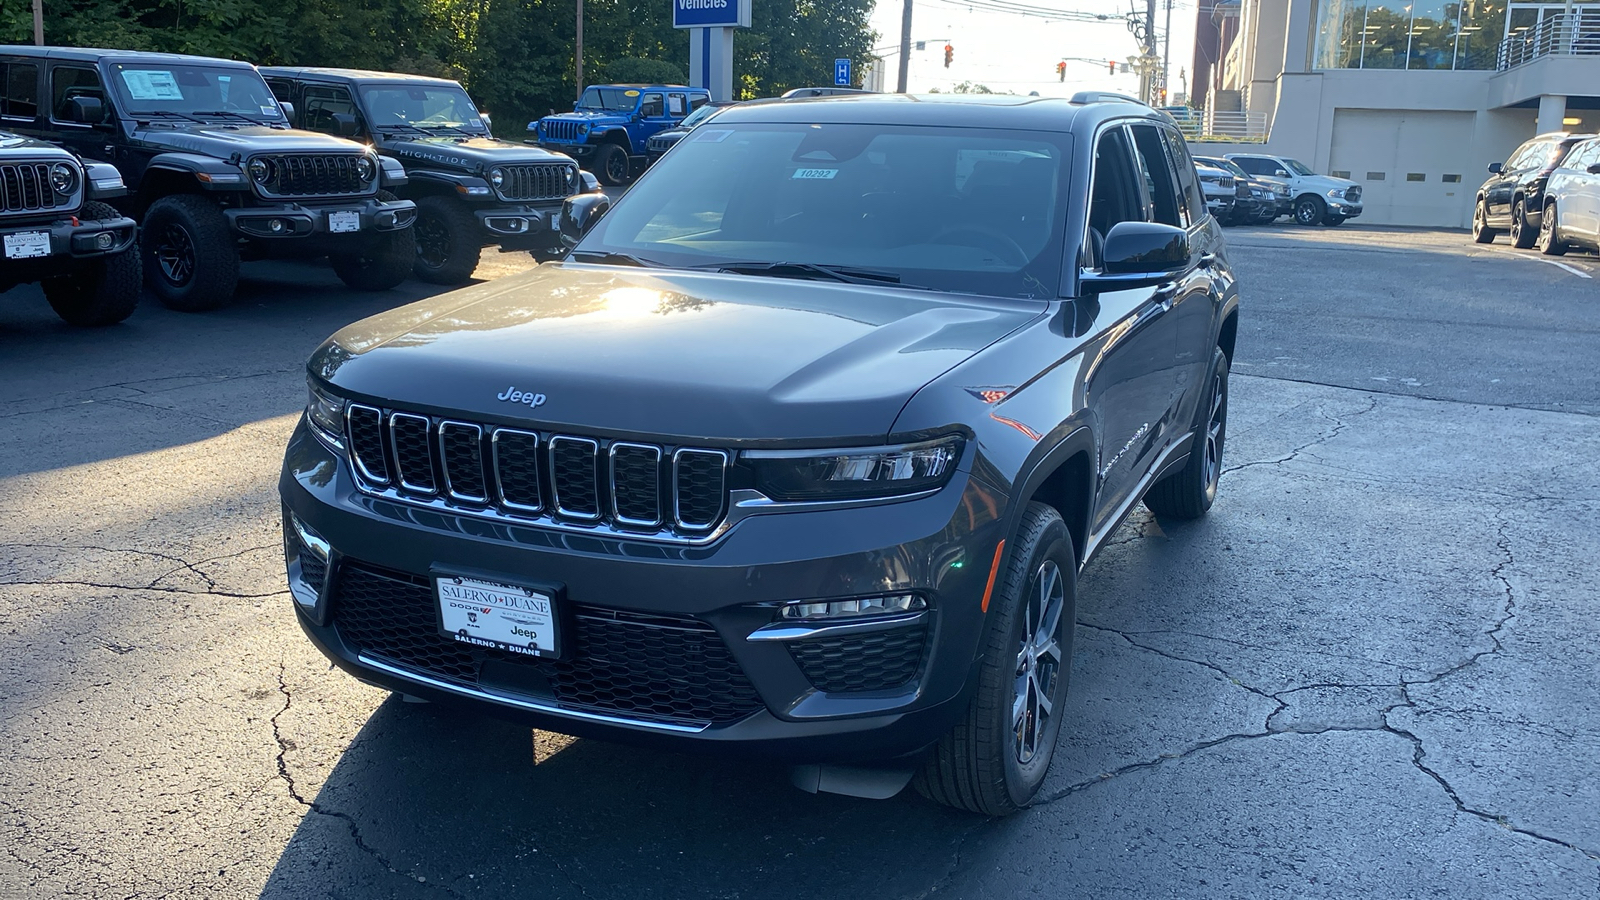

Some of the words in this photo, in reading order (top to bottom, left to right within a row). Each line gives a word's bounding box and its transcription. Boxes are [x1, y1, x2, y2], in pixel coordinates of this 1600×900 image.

[679, 0, 728, 10] Vehicles
[838, 65, 847, 77] H
[801, 169, 831, 178] 10292
[497, 386, 547, 409] Jeep
[442, 586, 498, 604] SALERNO
[505, 596, 549, 613] DUANE
[511, 626, 537, 640] Jeep
[454, 635, 496, 648] SALERNO
[509, 645, 541, 656] DUANE
